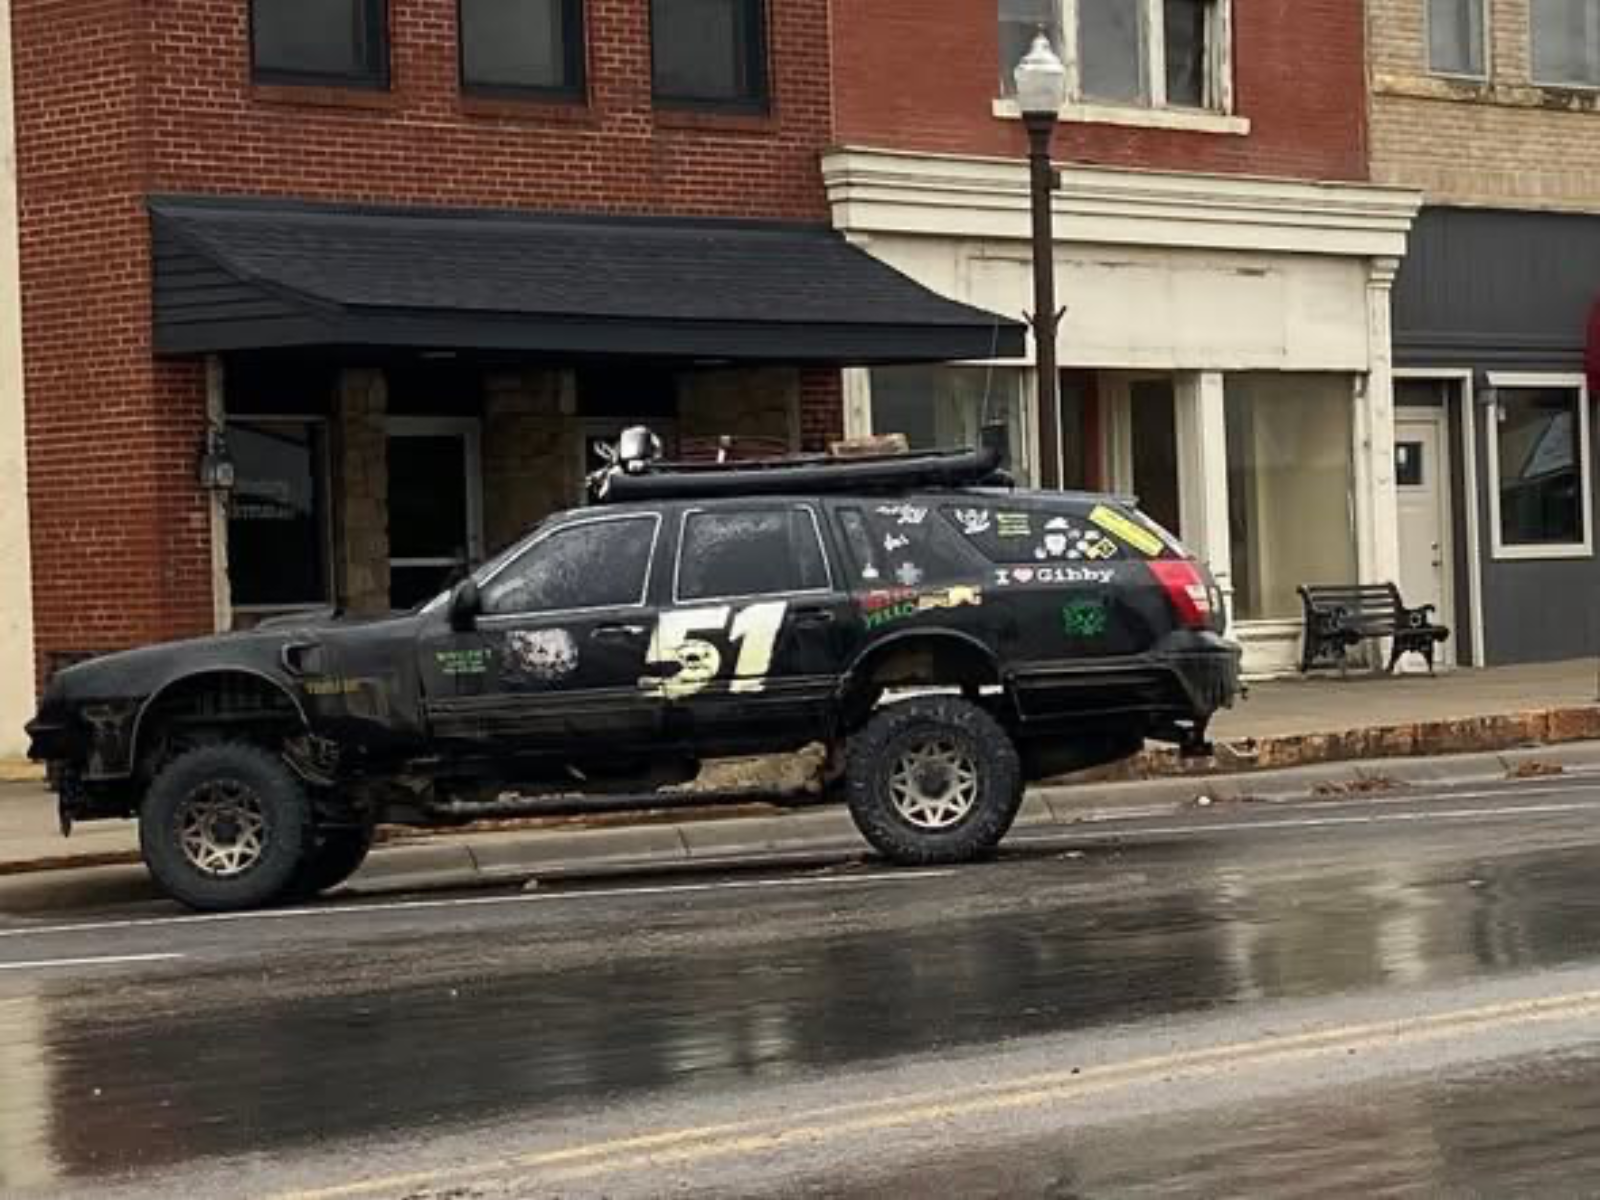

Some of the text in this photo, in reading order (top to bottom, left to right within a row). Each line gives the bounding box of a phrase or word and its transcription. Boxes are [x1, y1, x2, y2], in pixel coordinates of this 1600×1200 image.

[996, 567, 1114, 585] I Gibby
[637, 601, 787, 699] 51
